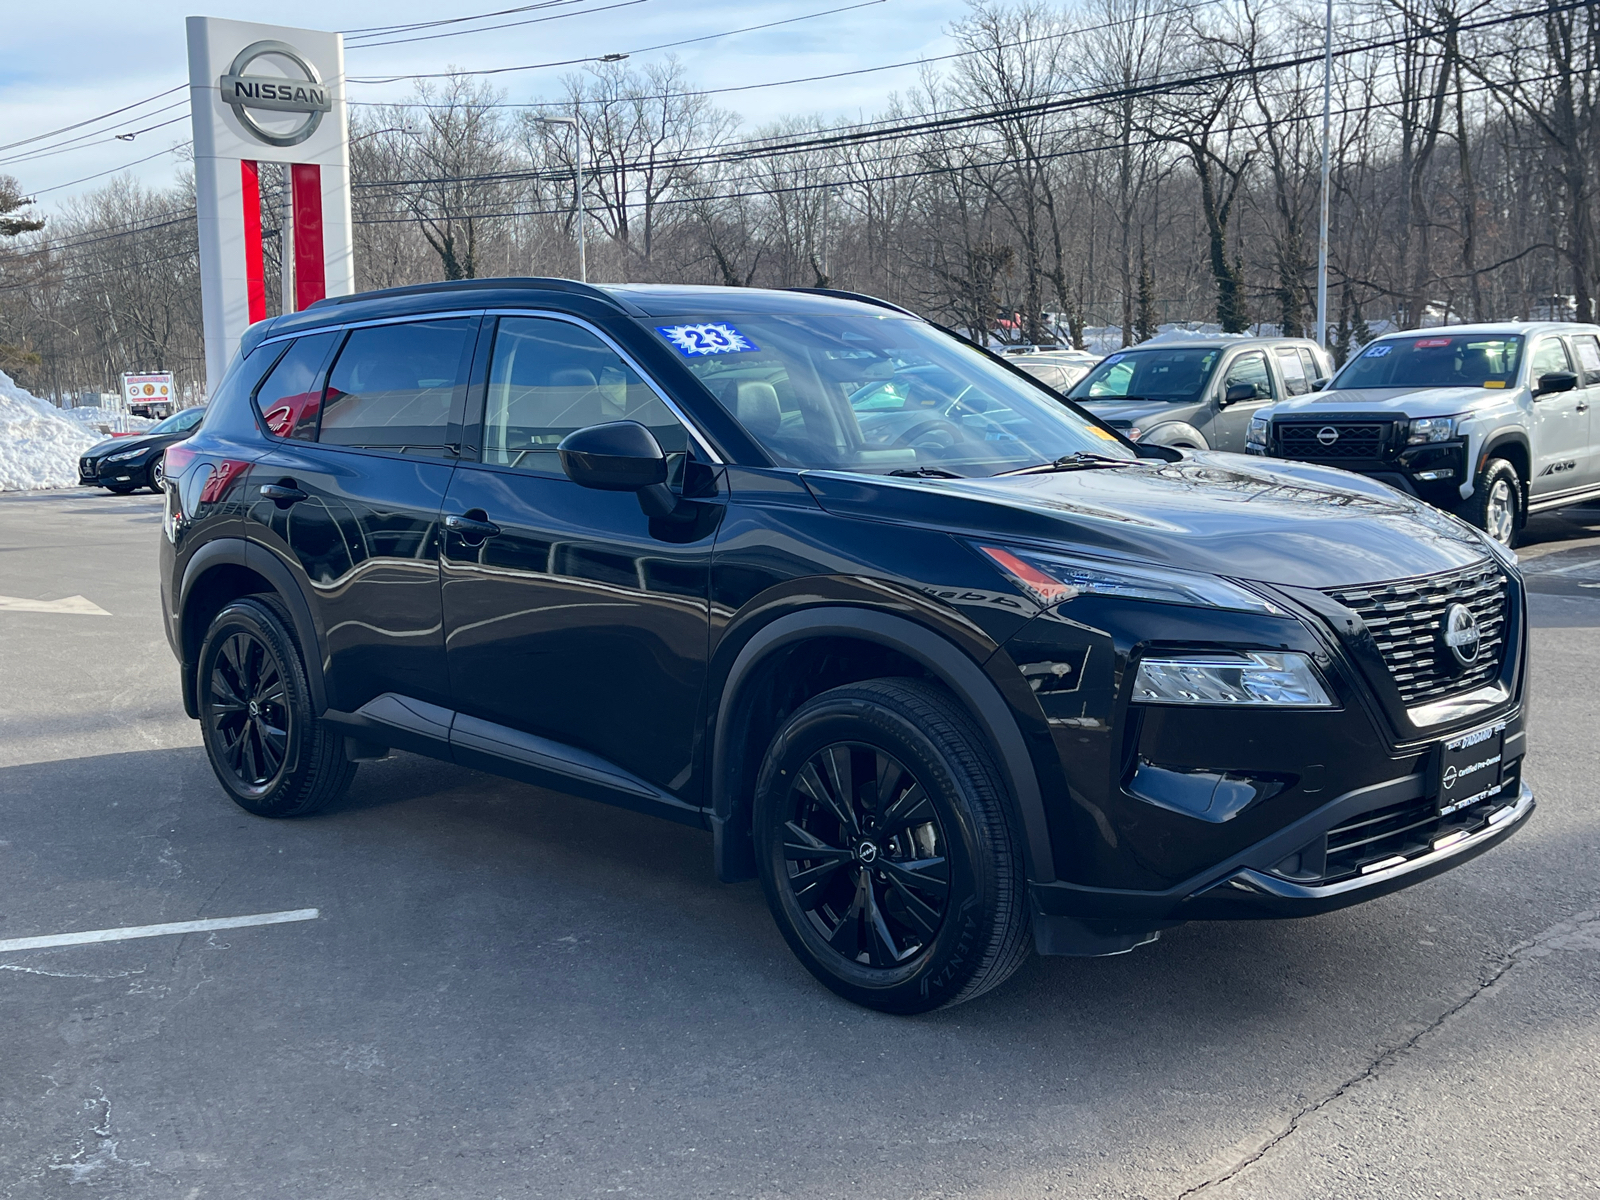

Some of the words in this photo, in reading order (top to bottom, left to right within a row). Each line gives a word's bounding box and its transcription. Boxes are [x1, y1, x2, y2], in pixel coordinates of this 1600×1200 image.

[235, 82, 324, 105] NISSAN
[684, 328, 730, 348] 23
[1448, 627, 1481, 645] NISSAN
[1458, 762, 1478, 777] Certified
[1477, 753, 1501, 770] Pre-Owned
[932, 915, 977, 988] ALENZA
